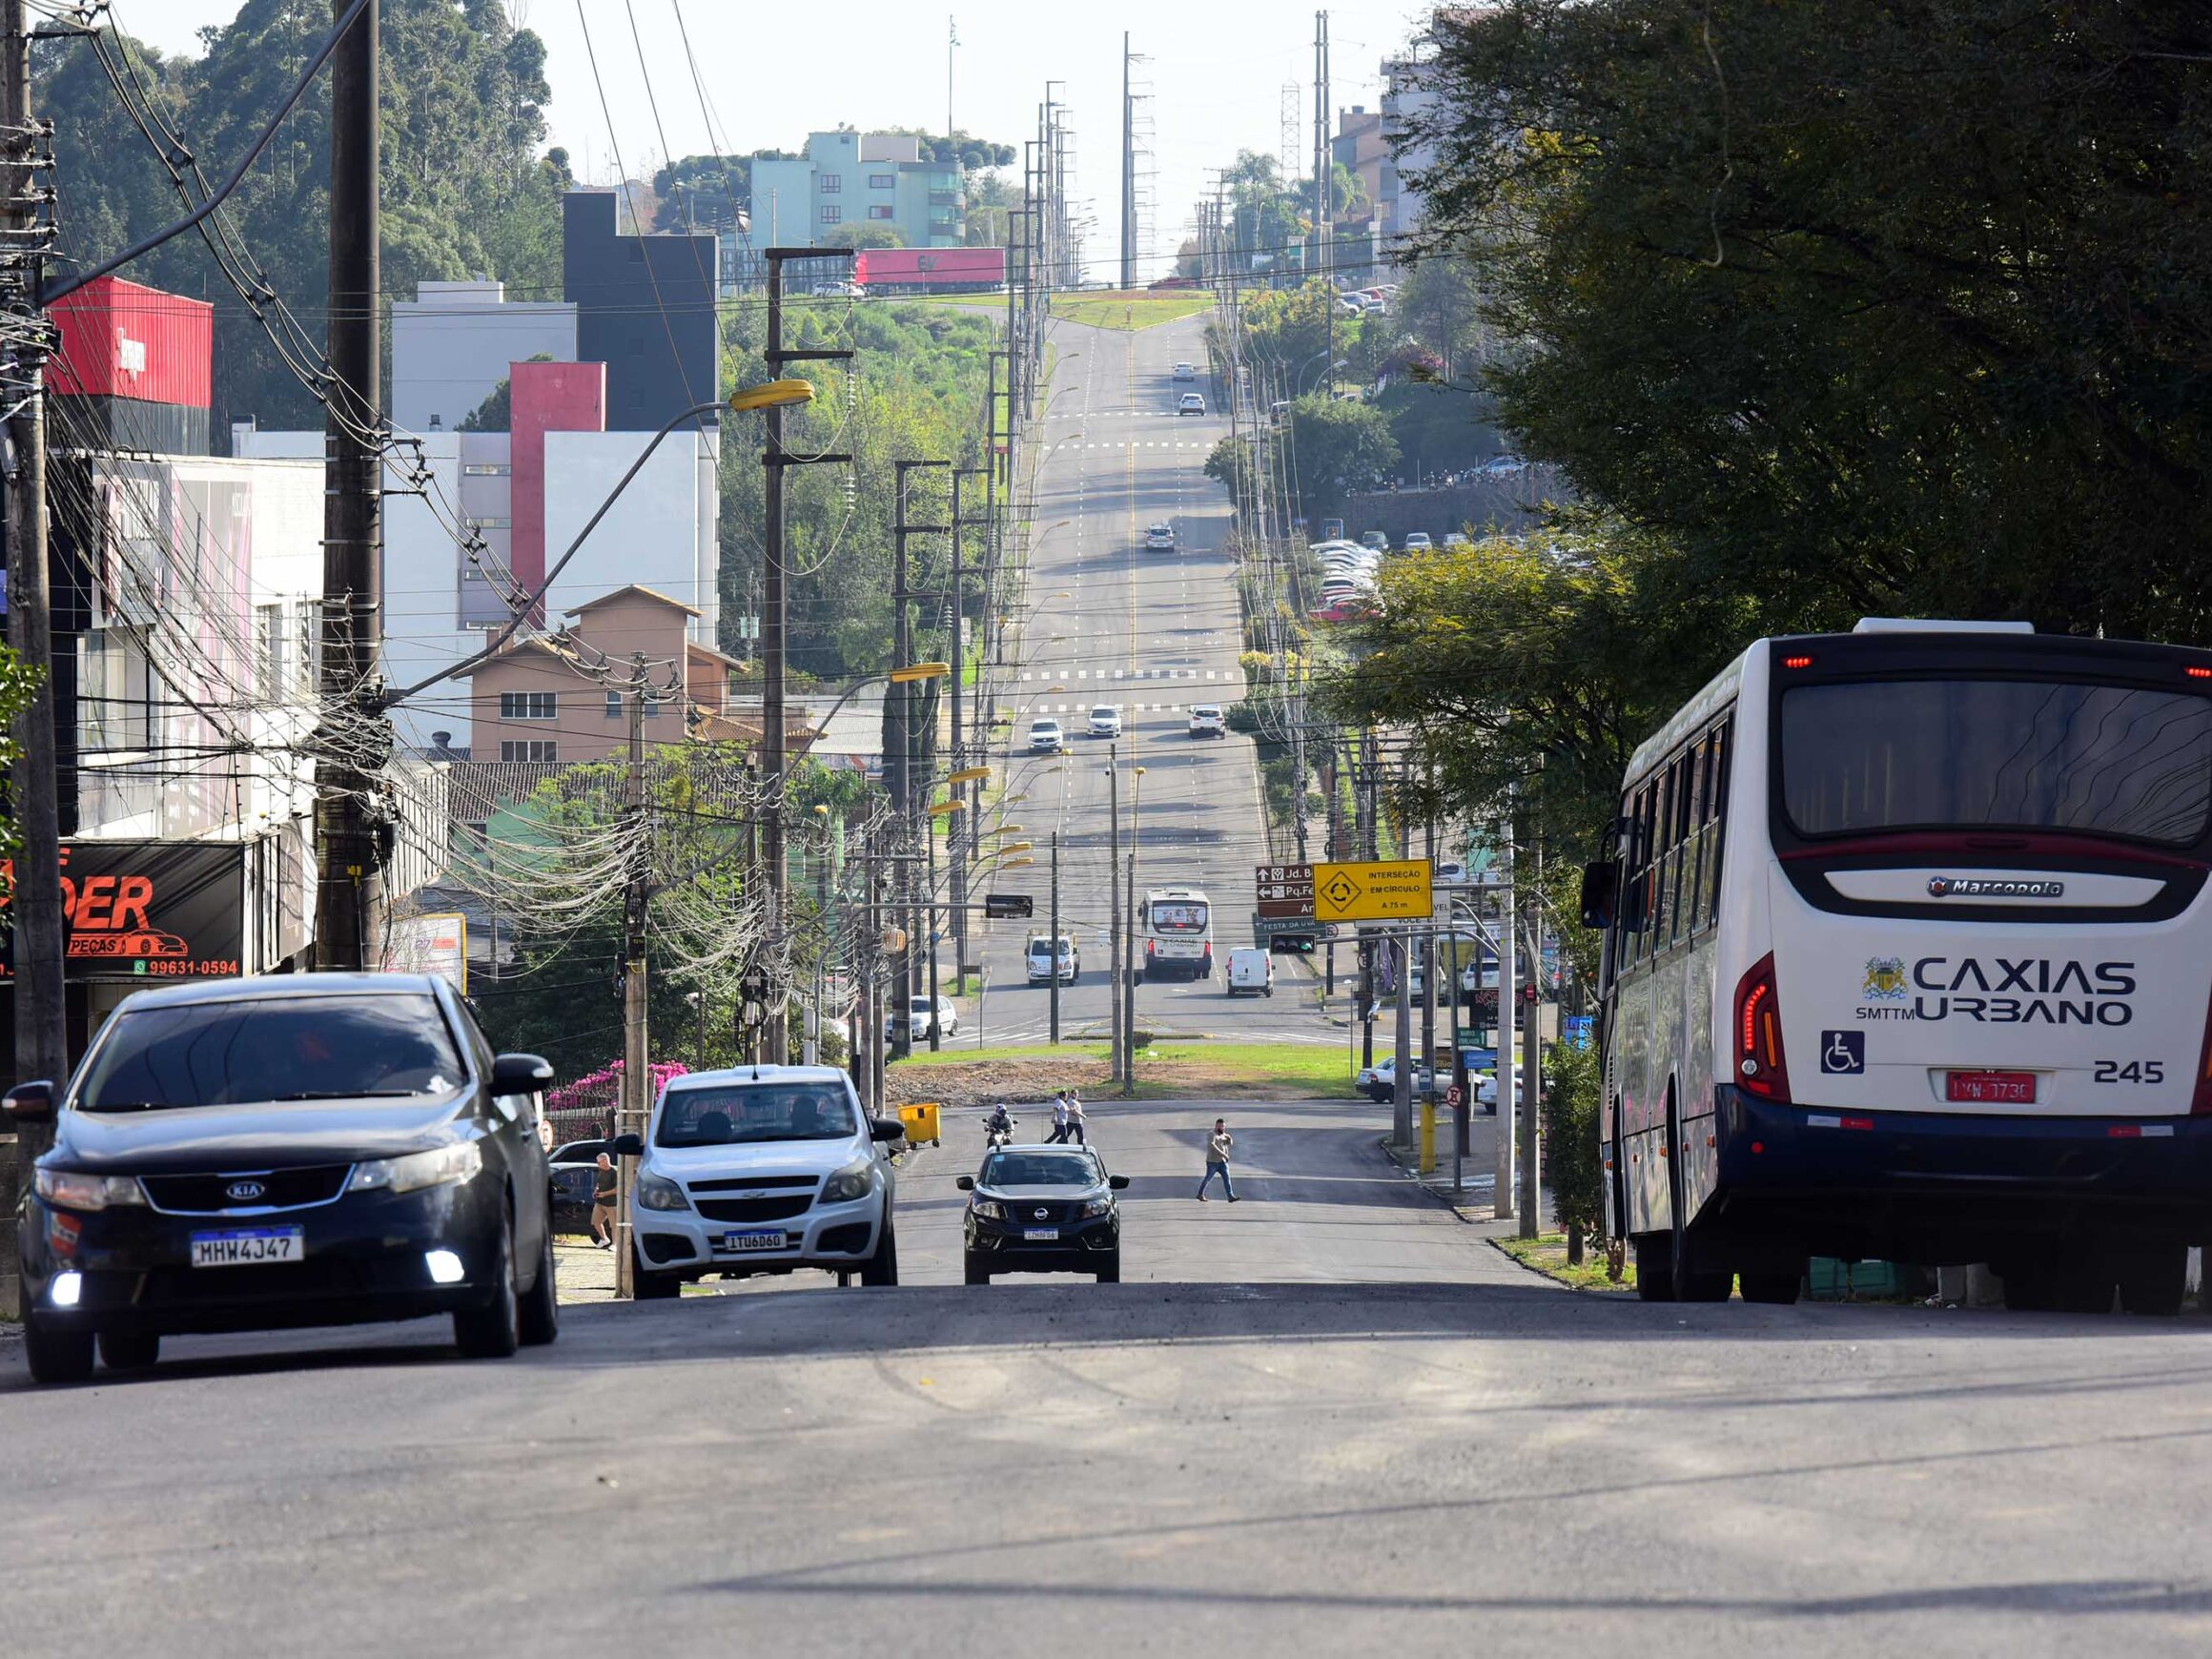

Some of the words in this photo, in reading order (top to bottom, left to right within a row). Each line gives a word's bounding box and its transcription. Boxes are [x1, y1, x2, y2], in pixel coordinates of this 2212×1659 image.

[1286, 868, 1302, 878] Jd.
[1368, 870, 1421, 879] INTERSEÇÃO
[1383, 885, 1420, 893] CÍRCULO
[1953, 880, 2061, 895] Marcopolo
[1264, 922, 1287, 931] FESTA
[72, 938, 116, 953] PEÇAS
[150, 960, 238, 975] 99631-0594
[1913, 956, 2137, 995] CAXIAS
[1855, 1006, 1915, 1021] SMTTM
[1915, 996, 2133, 1026] URBANO
[2094, 1060, 2163, 1084] 245
[233, 1184, 259, 1196] KIA
[199, 1239, 291, 1262] MHW4J47
